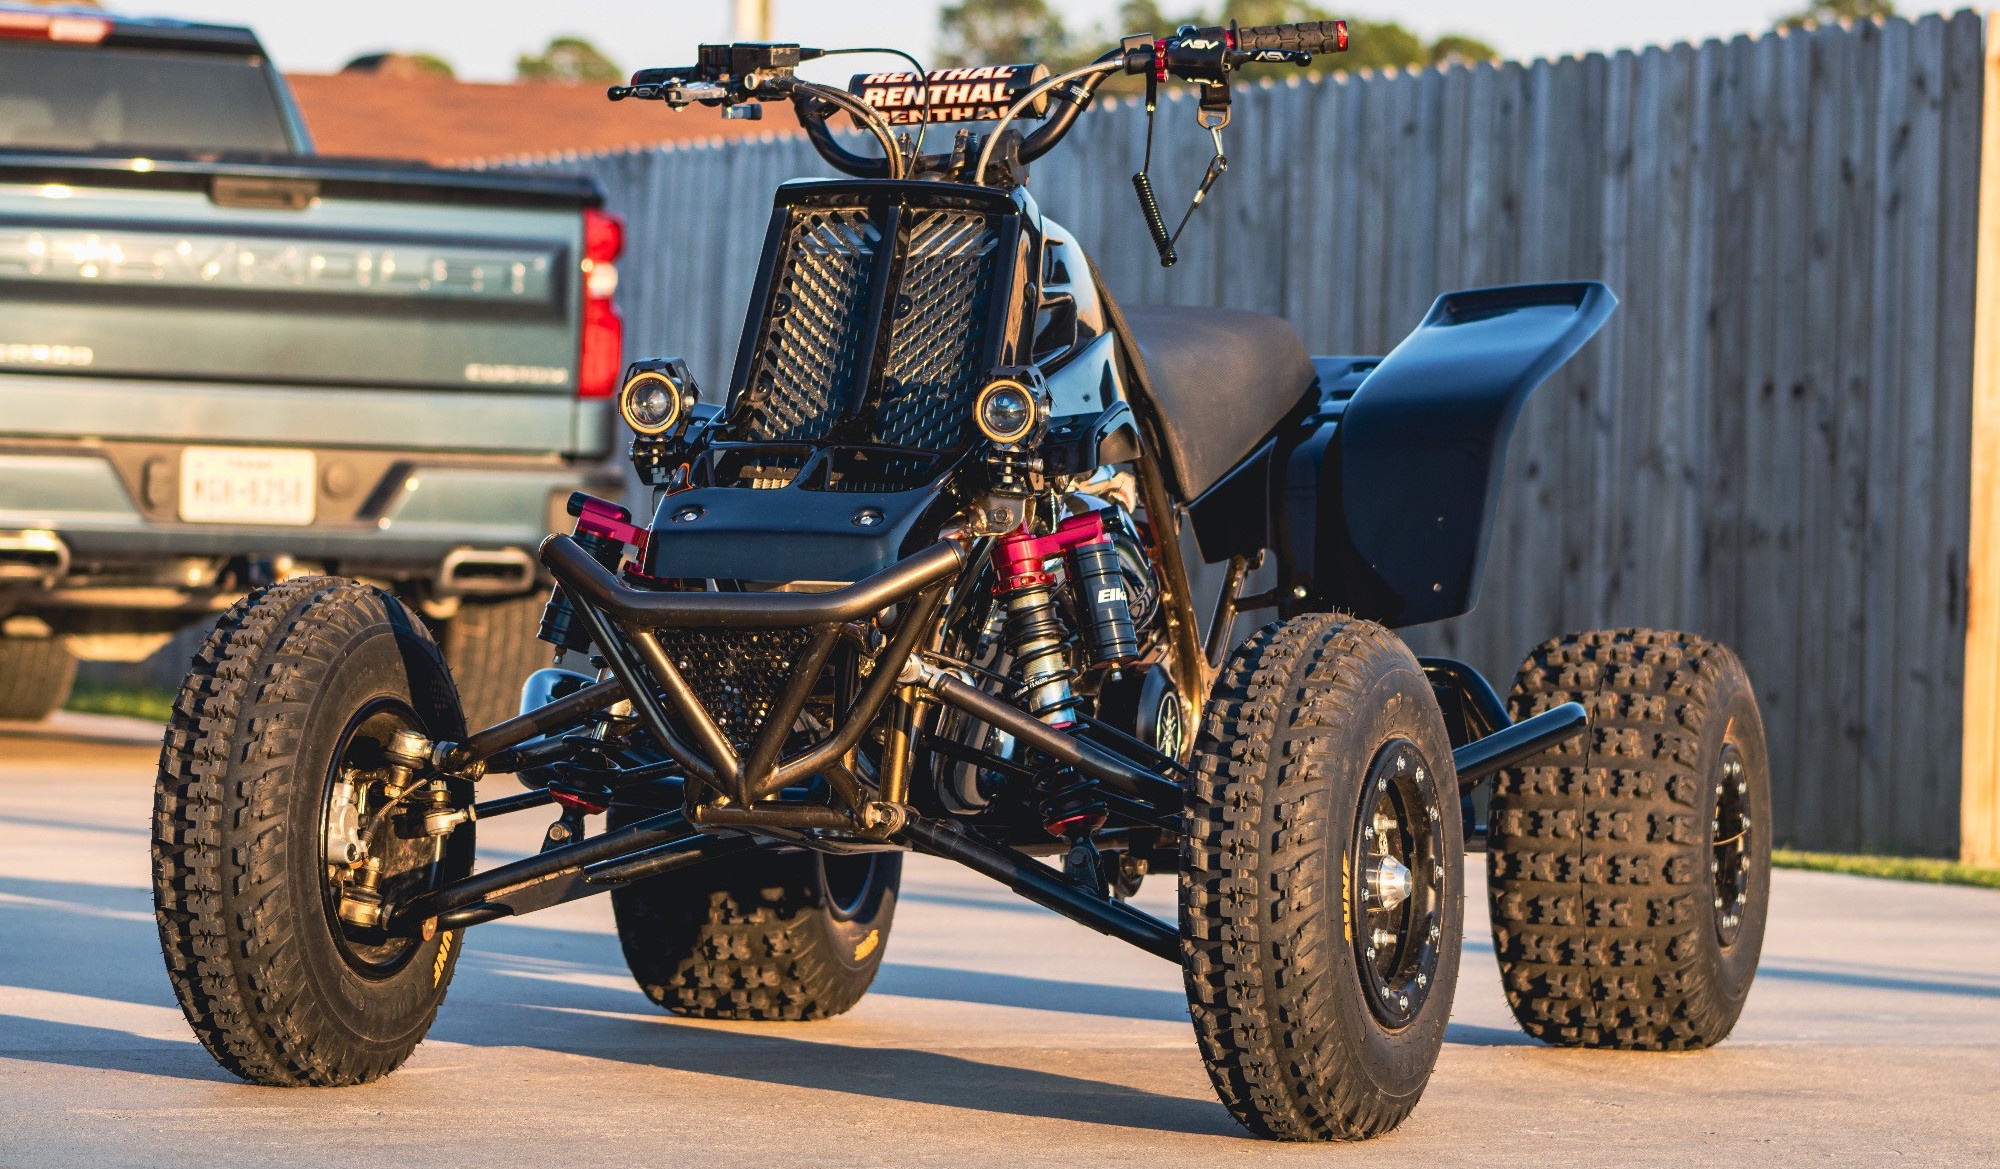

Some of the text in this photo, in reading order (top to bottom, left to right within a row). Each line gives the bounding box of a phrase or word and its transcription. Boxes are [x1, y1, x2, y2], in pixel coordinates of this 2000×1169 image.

[1181, 39, 1219, 50] ASV
[1255, 51, 1292, 61] ASV
[863, 83, 1012, 107] RENTHAL
[433, 930, 453, 989] UNF
